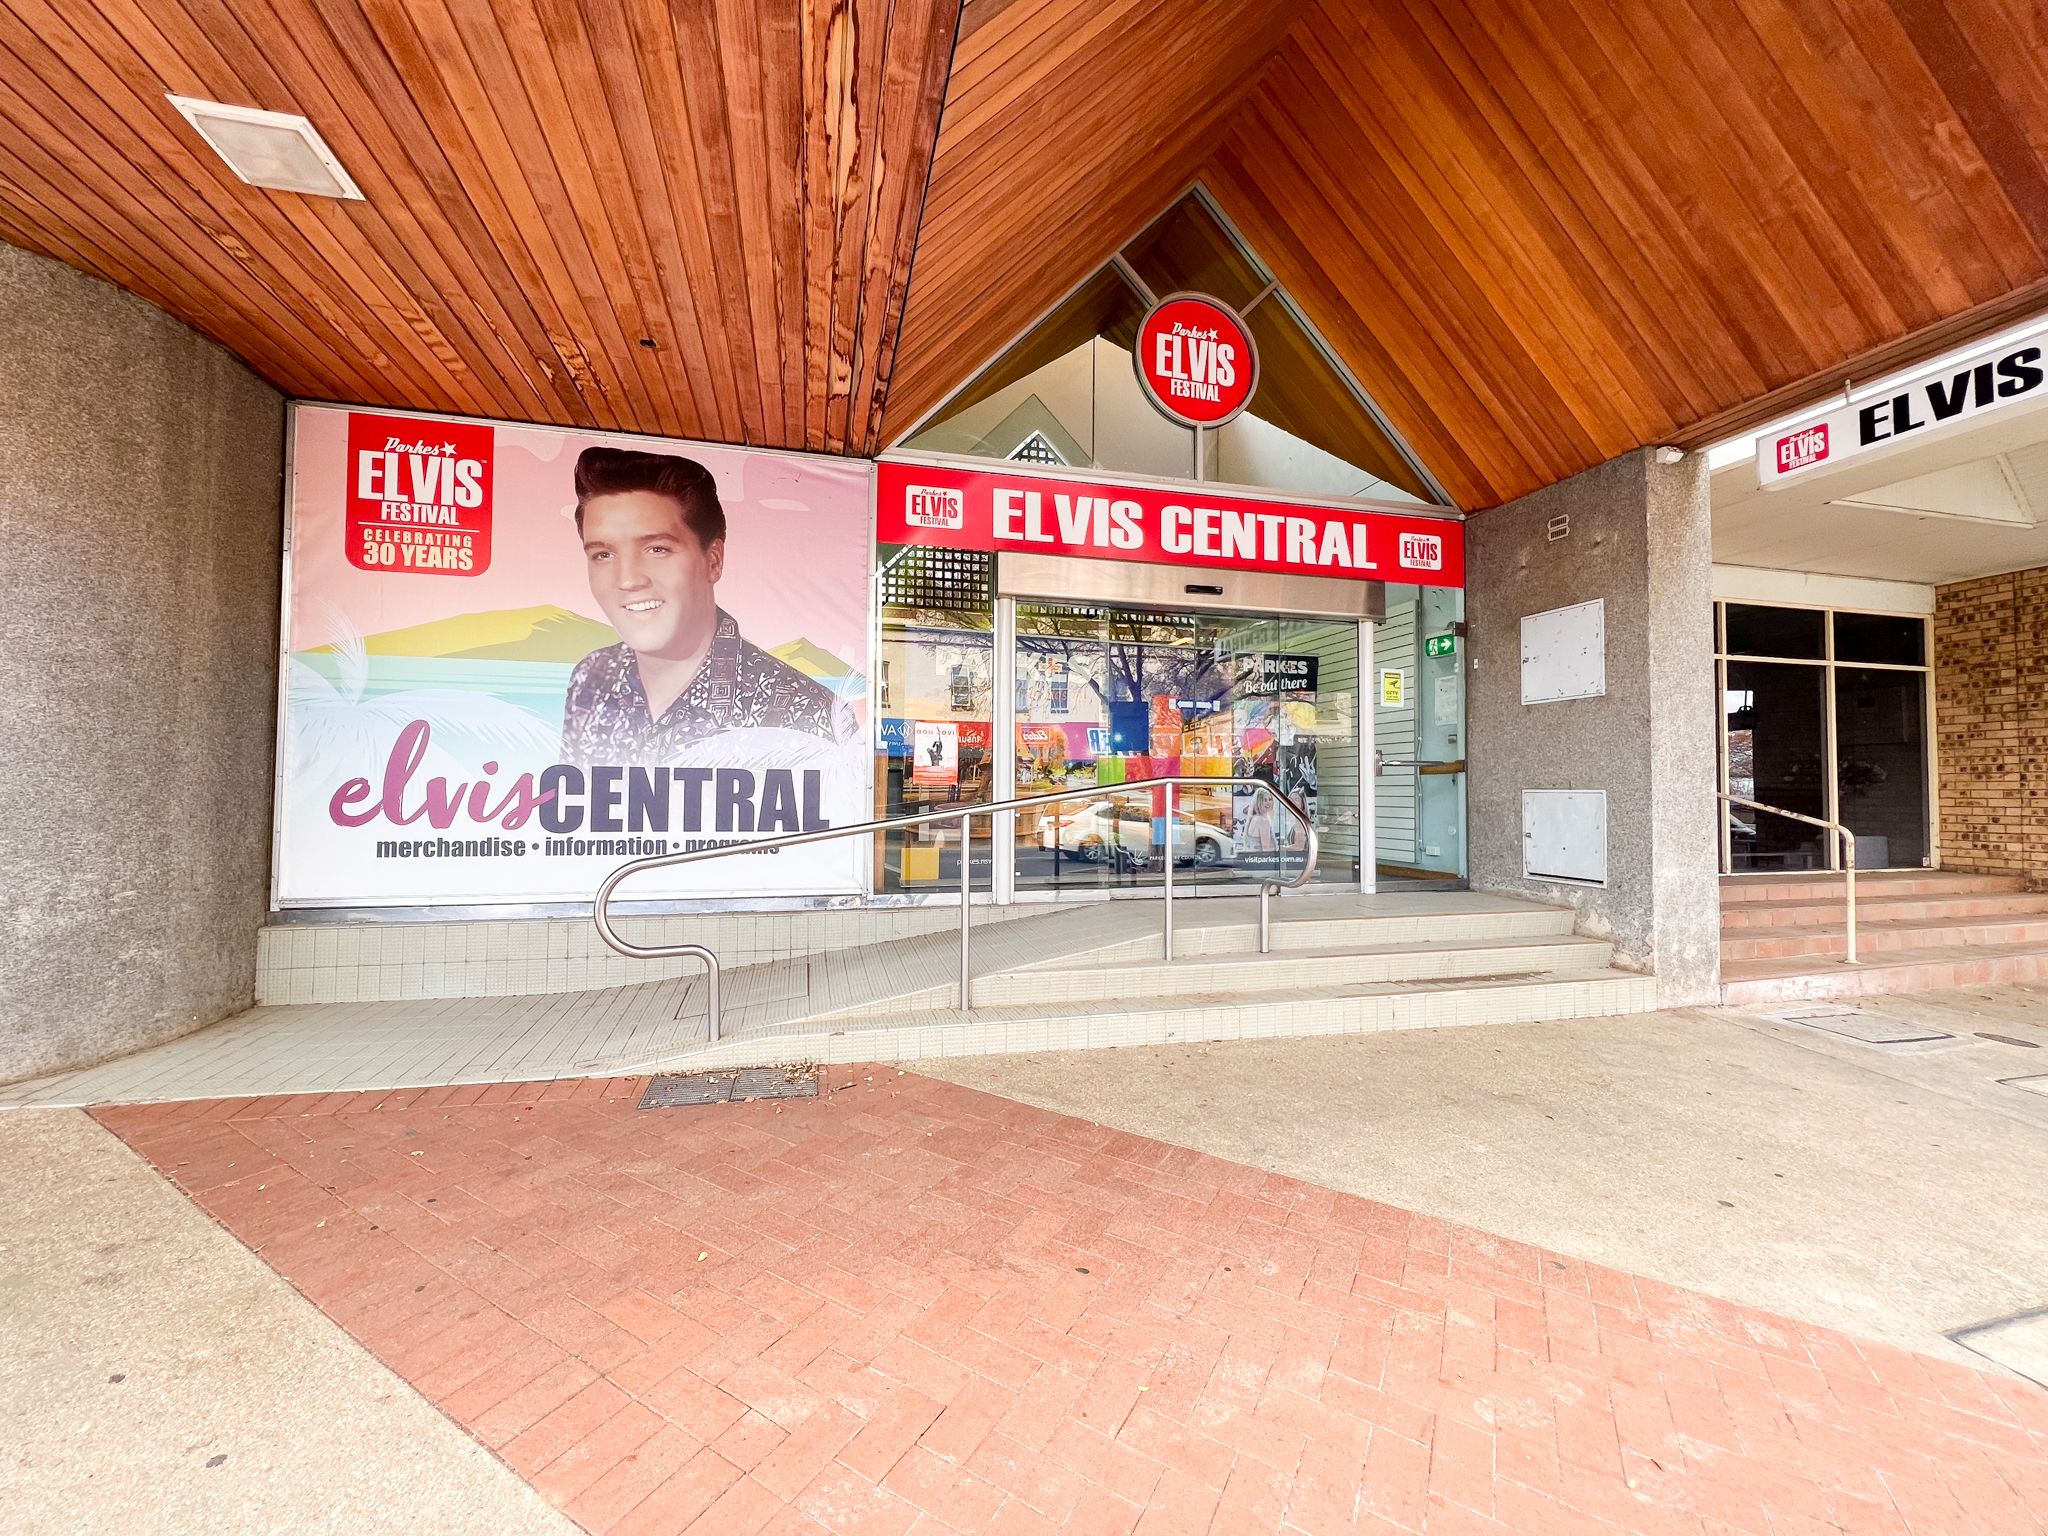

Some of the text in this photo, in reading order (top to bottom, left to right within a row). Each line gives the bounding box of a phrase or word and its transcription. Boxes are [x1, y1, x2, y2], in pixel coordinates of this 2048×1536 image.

[1172, 321, 1208, 339] Parkes
[1156, 332, 1236, 387] ELVIS
[1170, 378, 1221, 403] FESTIVAL
[1859, 347, 2044, 447] ELVIS
[383, 436, 440, 456] Parkes
[1781, 431, 1826, 464] ELVIS
[358, 449, 483, 508] ELVIS
[381, 501, 460, 526] FESTIVAL
[911, 494, 958, 519] ELVIS
[920, 516, 950, 526] FESTIVAL
[992, 488, 1377, 570] ELVIS CENTRAL
[363, 528, 473, 548] CELEBRATING
[363, 541, 474, 571] 30 YEARS
[1403, 541, 1438, 561] ELVIS
[1410, 559, 1432, 568] FESTIVAL
[1243, 659, 1308, 675] PARKES
[1243, 677, 1308, 693] Be out there
[328, 719, 830, 833] elvis CENTRAL
[376, 837, 526, 858] merchandise
[545, 836, 668, 856] information
[1244, 856, 1304, 864] visitparkes.com.au
